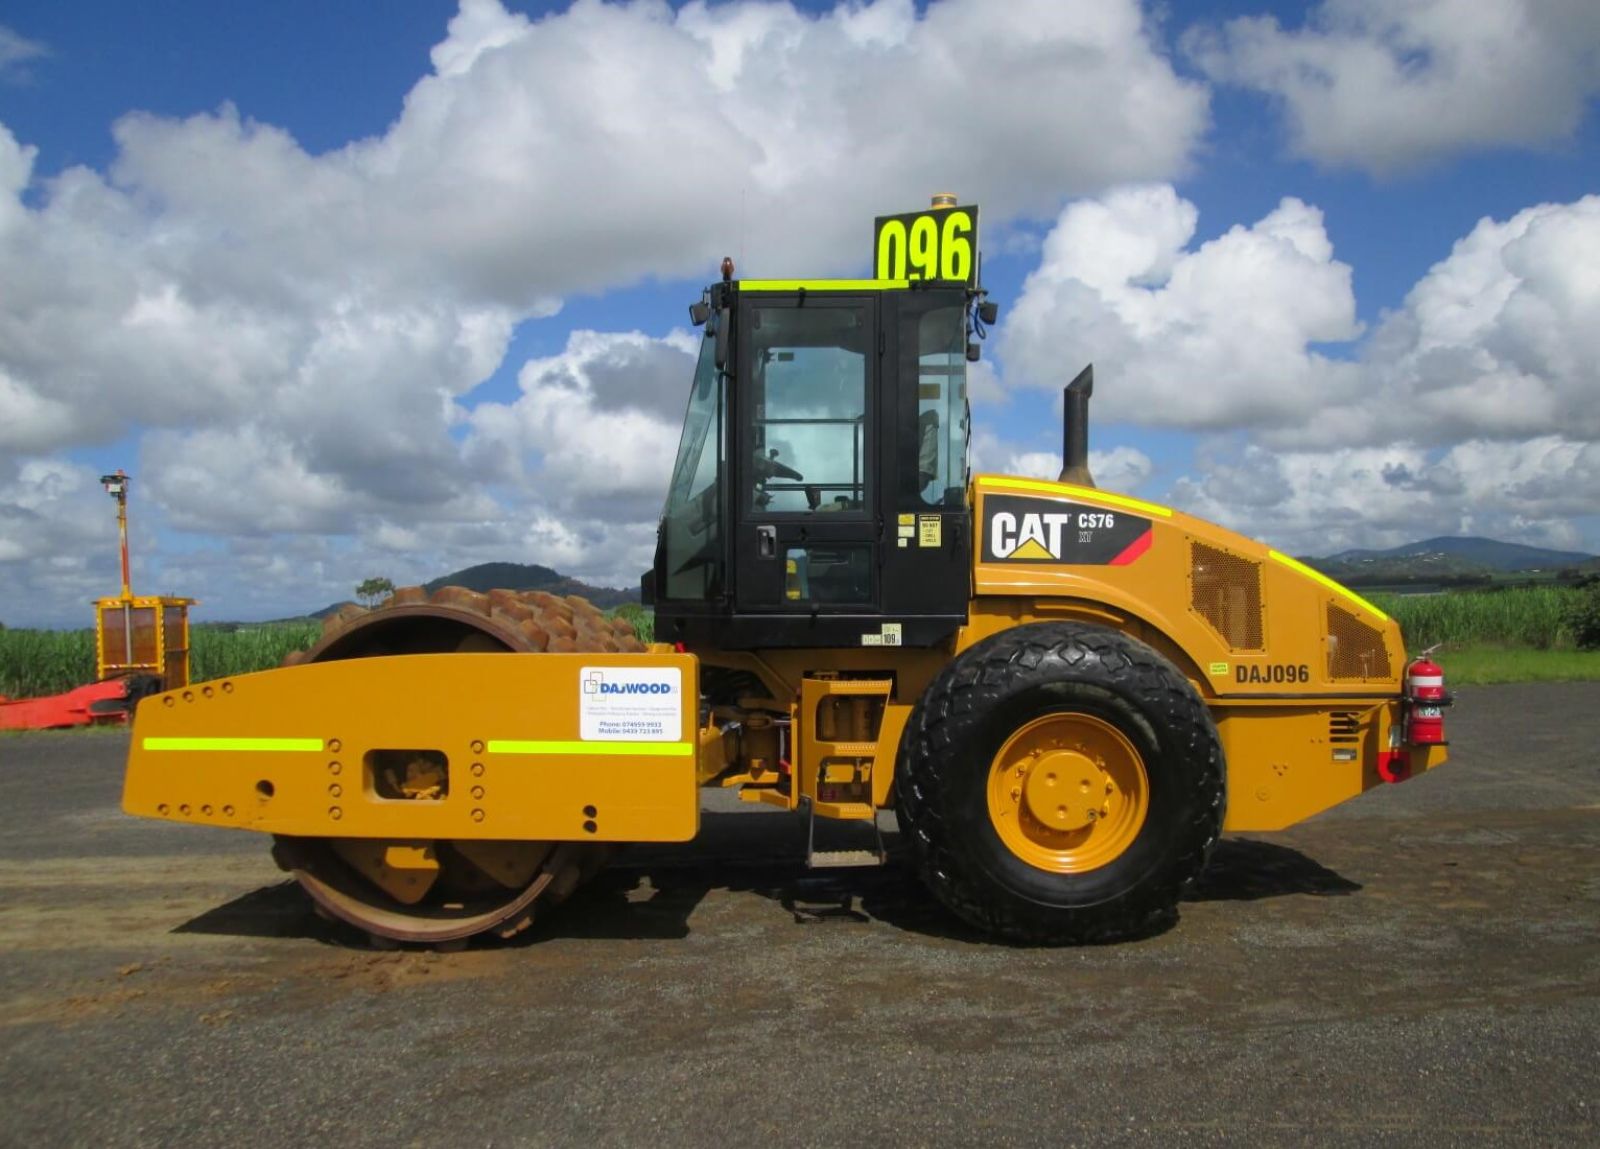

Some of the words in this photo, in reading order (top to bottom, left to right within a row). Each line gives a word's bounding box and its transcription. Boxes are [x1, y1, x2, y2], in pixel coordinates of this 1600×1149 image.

[878, 211, 971, 281] 096
[1078, 513, 1114, 529] CS76
[991, 512, 1068, 559] CAT
[1236, 664, 1309, 684] DAJ096
[598, 727, 620, 735] Mobile:
